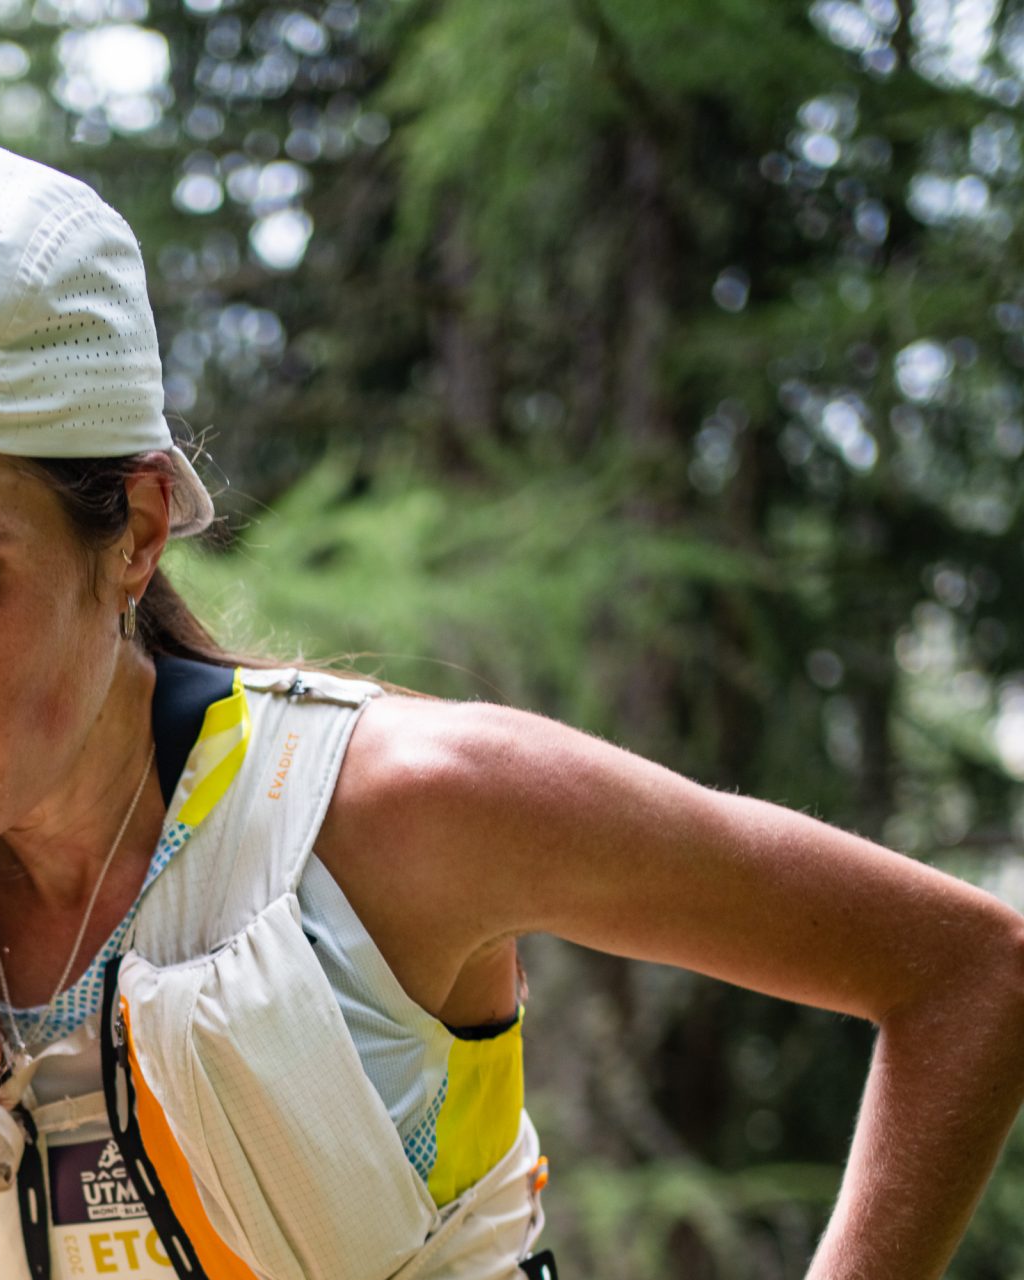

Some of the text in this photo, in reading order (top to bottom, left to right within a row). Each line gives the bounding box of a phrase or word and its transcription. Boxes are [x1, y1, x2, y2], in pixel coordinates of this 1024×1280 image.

[268, 732, 299, 799] EVADICT
[80, 1167, 127, 1182] DAC
[82, 1179, 140, 1205] UTM
